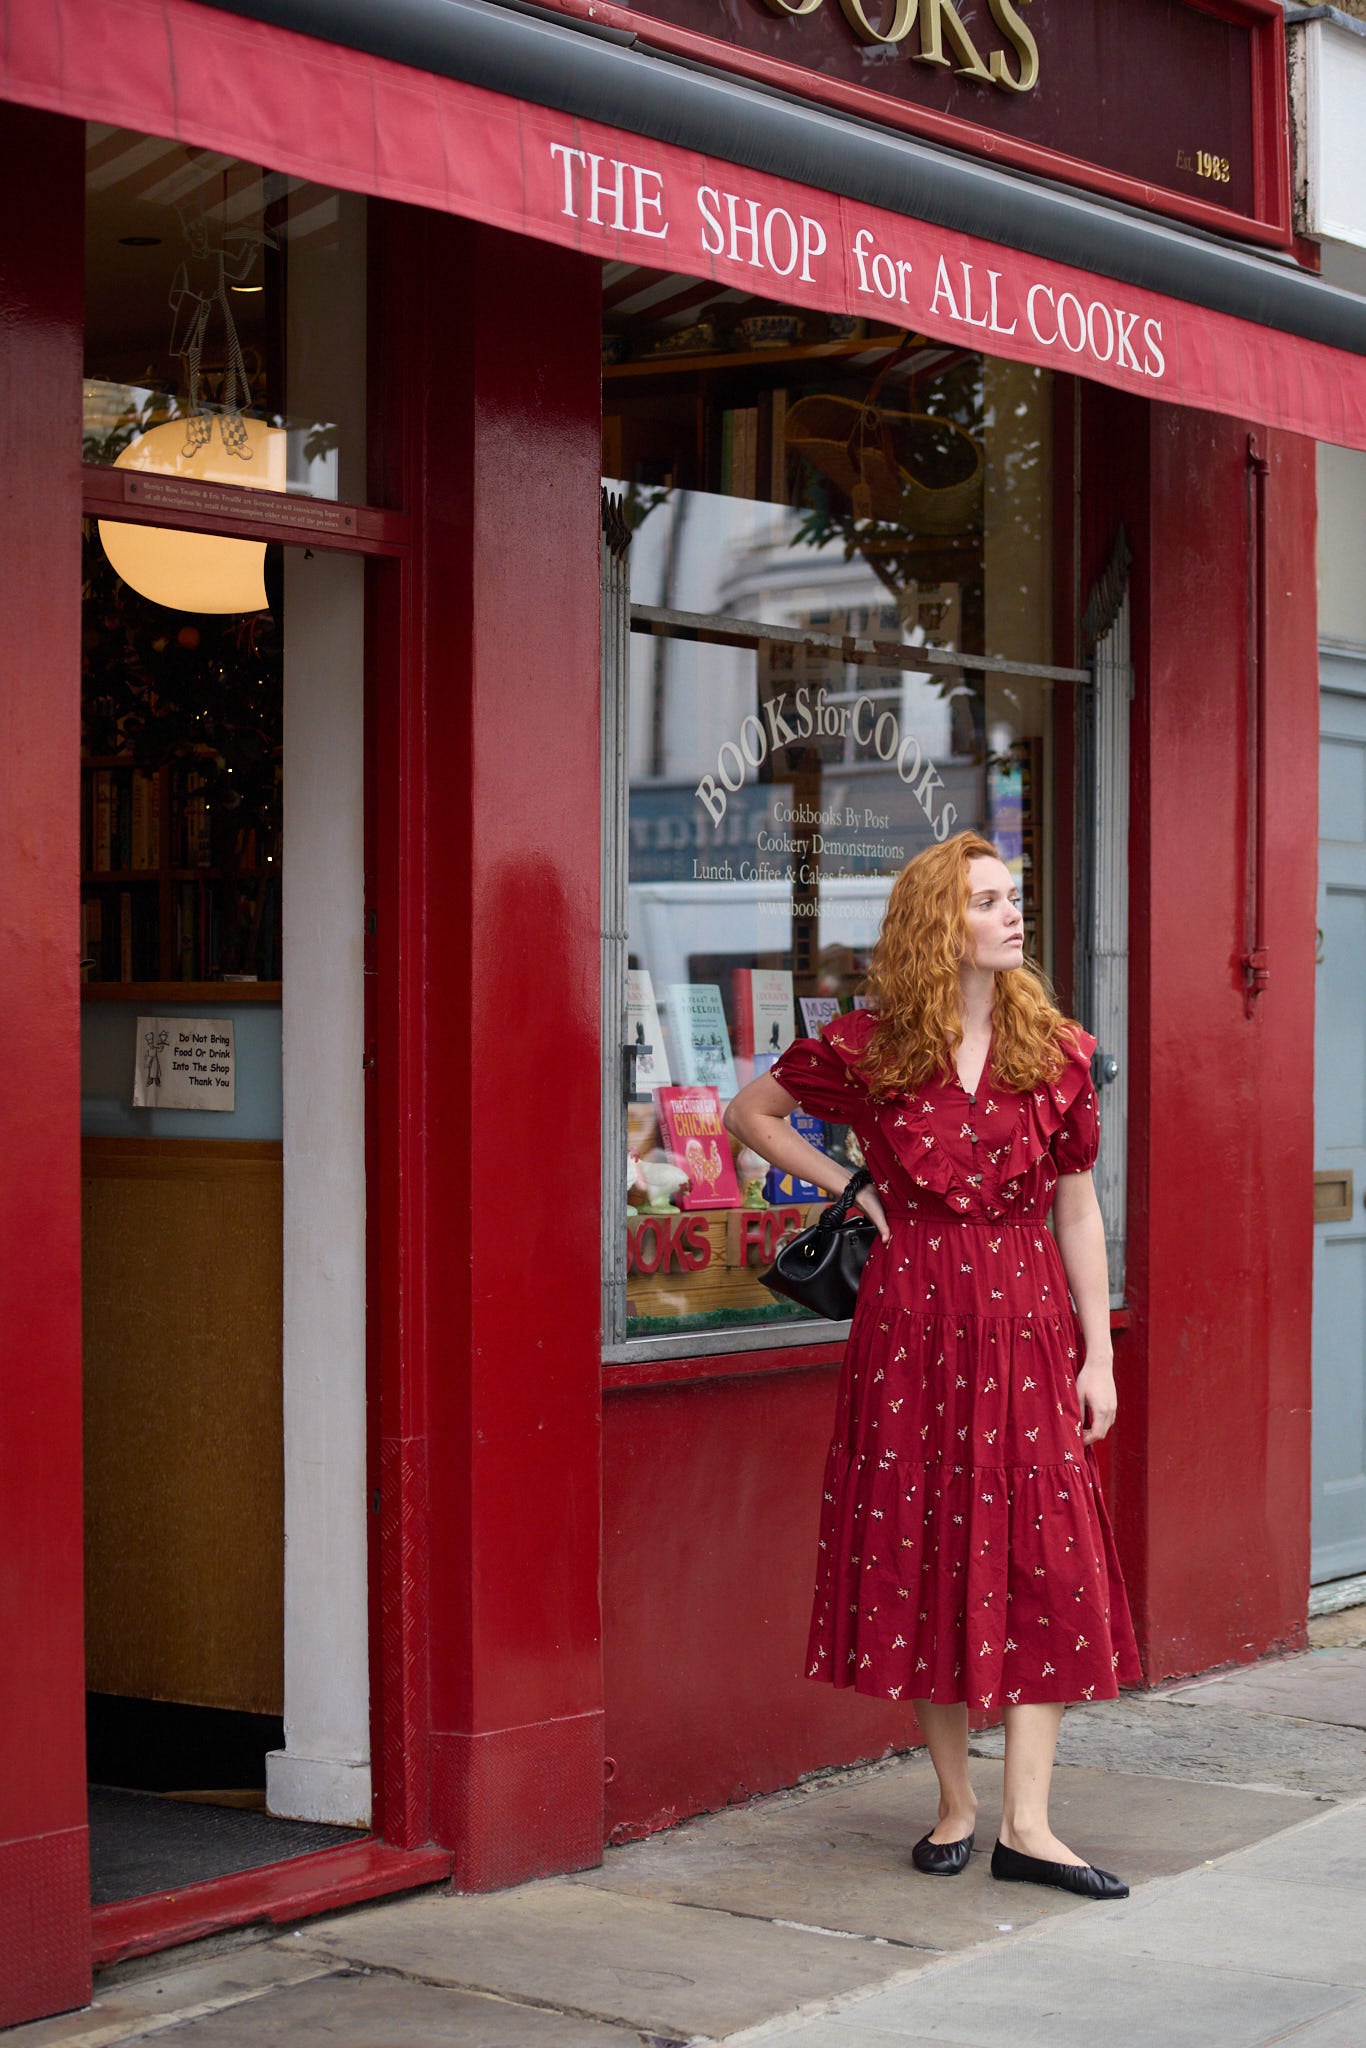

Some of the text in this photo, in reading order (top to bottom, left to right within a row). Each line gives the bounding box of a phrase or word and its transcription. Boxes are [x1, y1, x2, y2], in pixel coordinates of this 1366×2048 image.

[757, 0, 1039, 92] KS
[1196, 150, 1230, 183] 1983
[550, 142, 1165, 378] THE SHOP for ALL COOKS
[695, 687, 958, 842] BOOKS for COOKS
[773, 801, 842, 826] Cookbooks
[845, 807, 861, 834] By
[864, 808, 889, 829] Post
[757, 830, 905, 859] Cookery Demonstrations
[692, 858, 737, 883] Lunch,
[740, 861, 781, 882] Coffee
[784, 865, 796, 884] &
[800, 864, 834, 885] Cakes
[174, 1047, 230, 1058] Food Or Drink
[179, 1033, 230, 1047] Do Not Bring
[172, 1061, 230, 1075] Into The Shop
[188, 1076, 230, 1087] Thank You
[673, 1113, 722, 1137] CHICKEN
[627, 1217, 711, 1273] OKS
